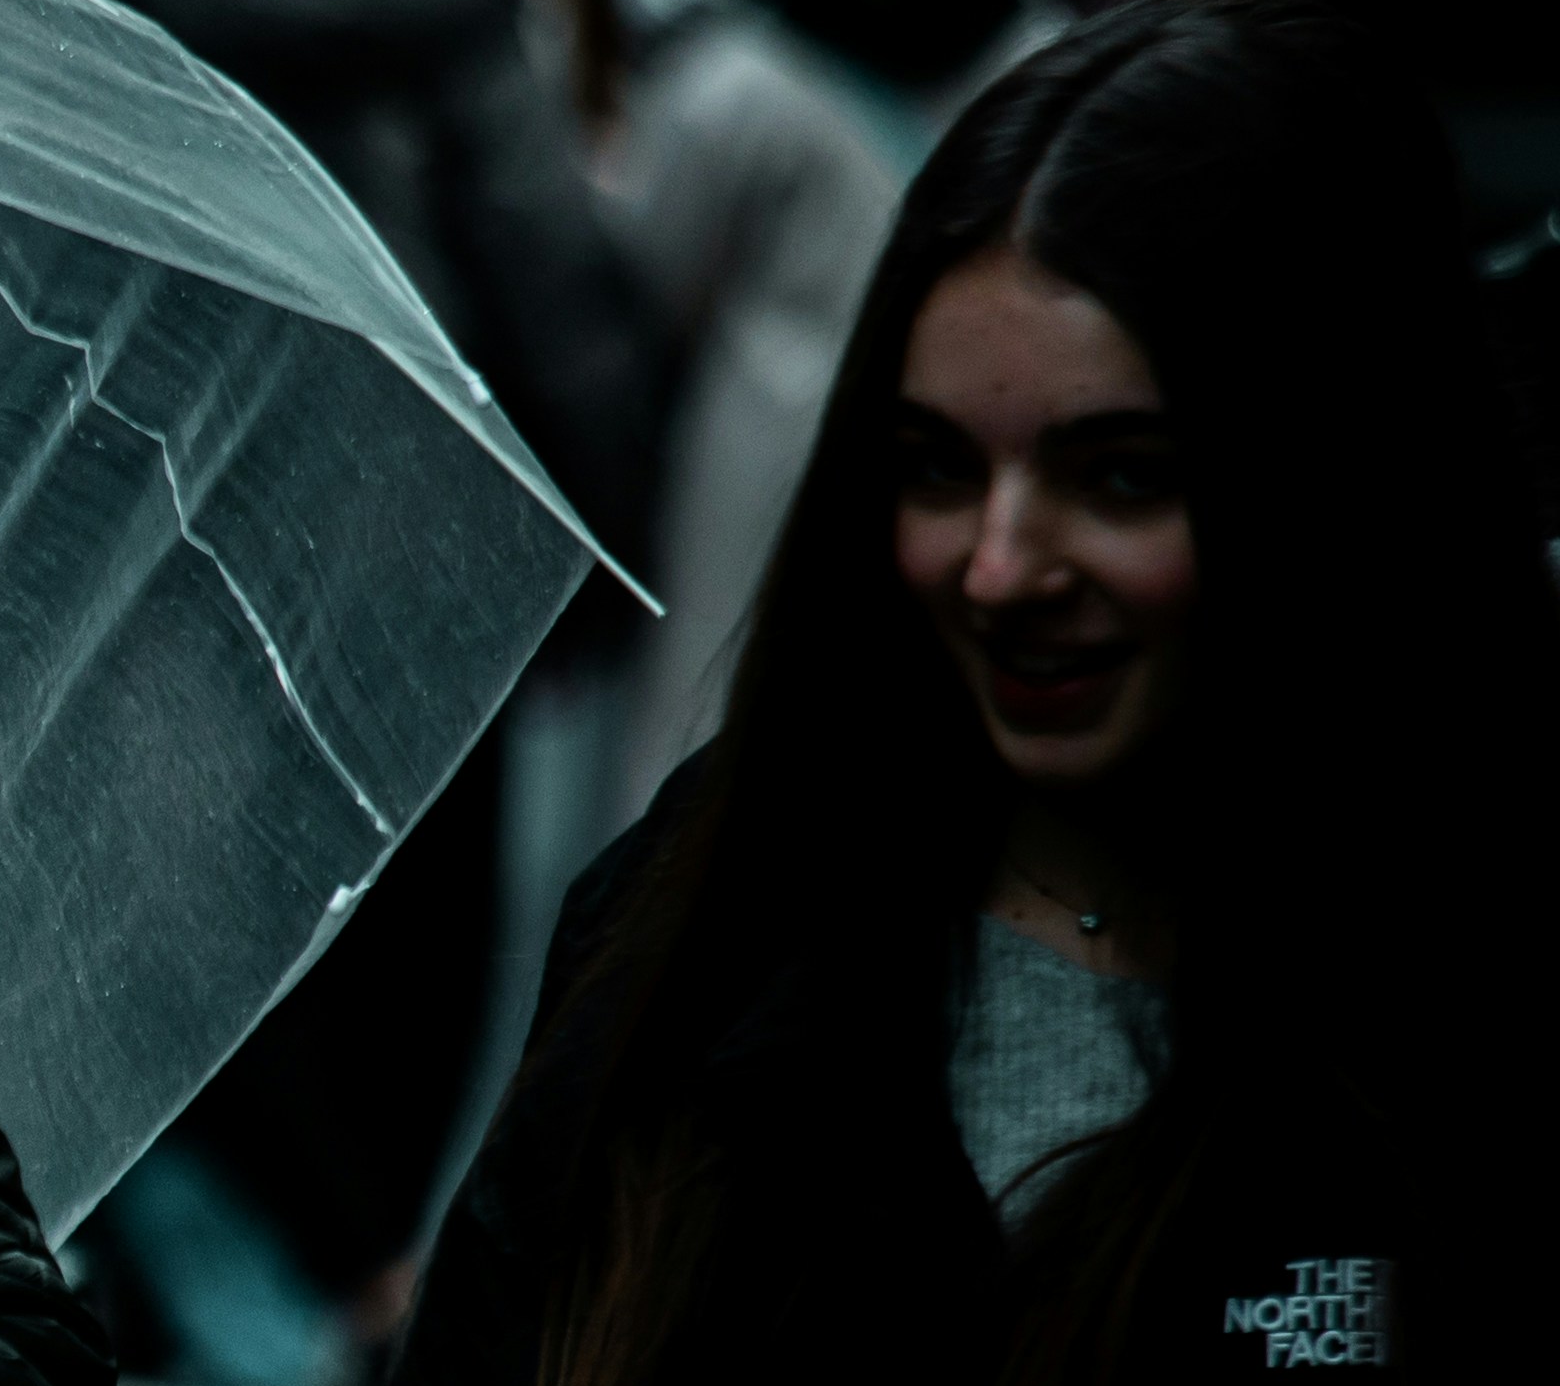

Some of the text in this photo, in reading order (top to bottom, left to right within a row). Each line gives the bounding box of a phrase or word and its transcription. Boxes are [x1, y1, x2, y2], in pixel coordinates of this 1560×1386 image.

[1284, 1256, 1375, 1294] THE
[1222, 1293, 1375, 1334] NORTH
[1264, 1329, 1375, 1369] FACE
